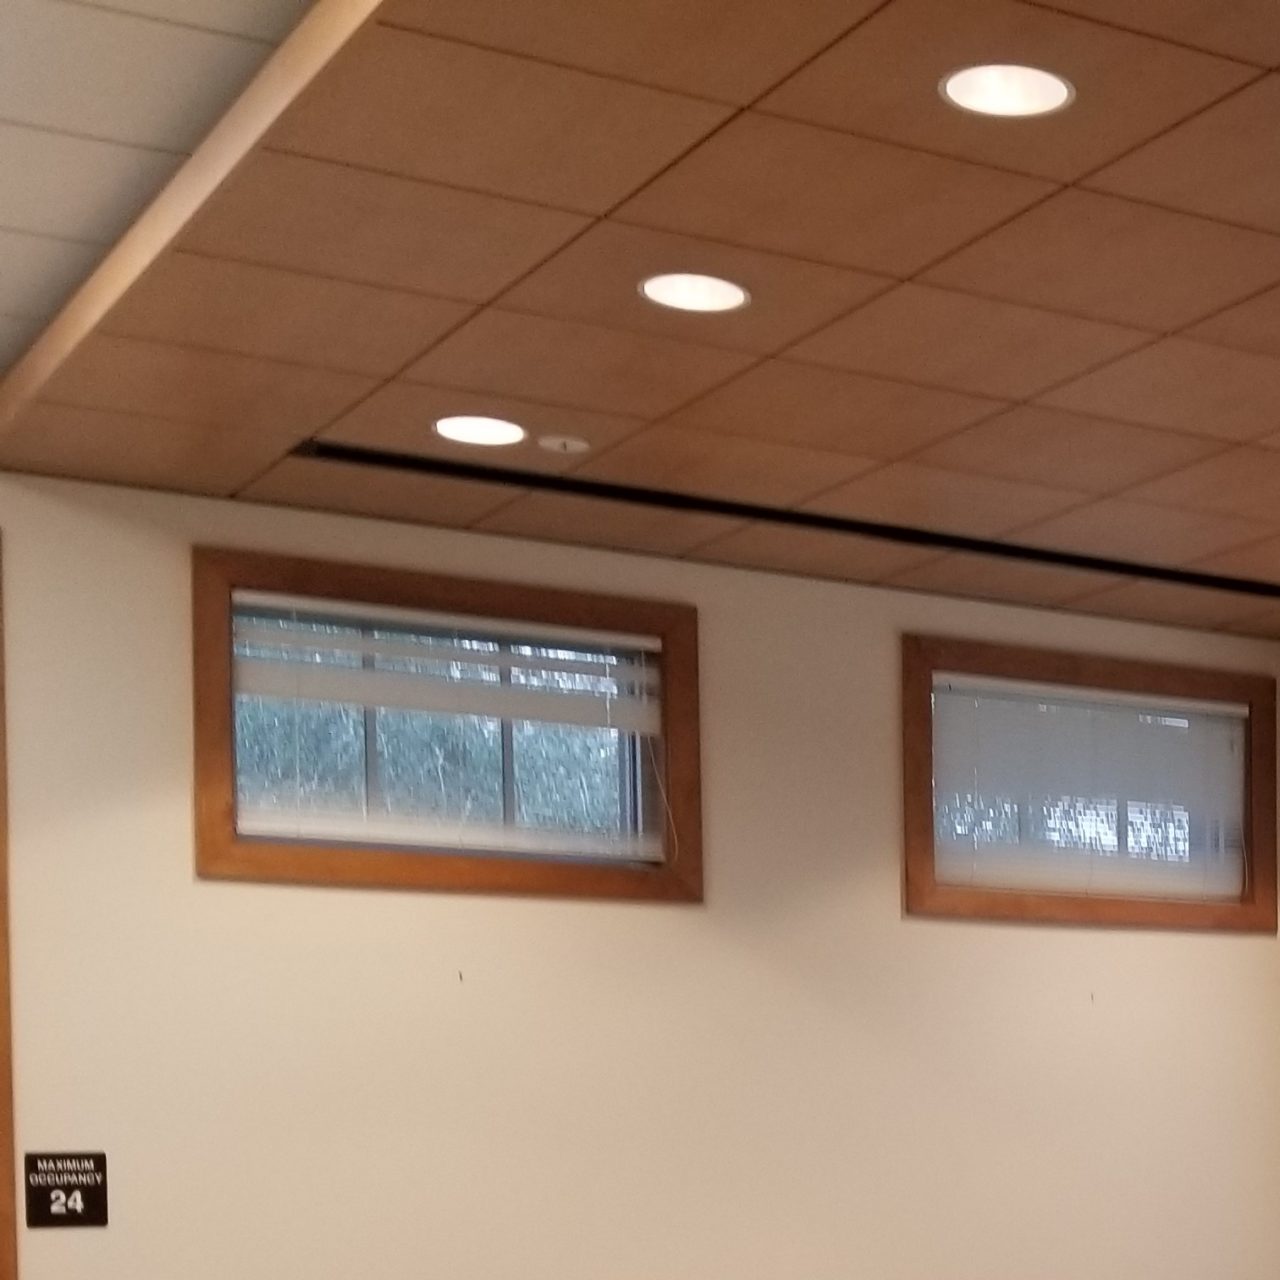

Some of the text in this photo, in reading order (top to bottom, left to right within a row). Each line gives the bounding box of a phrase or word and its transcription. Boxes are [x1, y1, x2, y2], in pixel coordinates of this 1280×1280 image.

[36, 1159, 95, 1172] MAXIMUM
[29, 1172, 103, 1187] OCCUPANCY
[50, 1189, 84, 1214] 24
